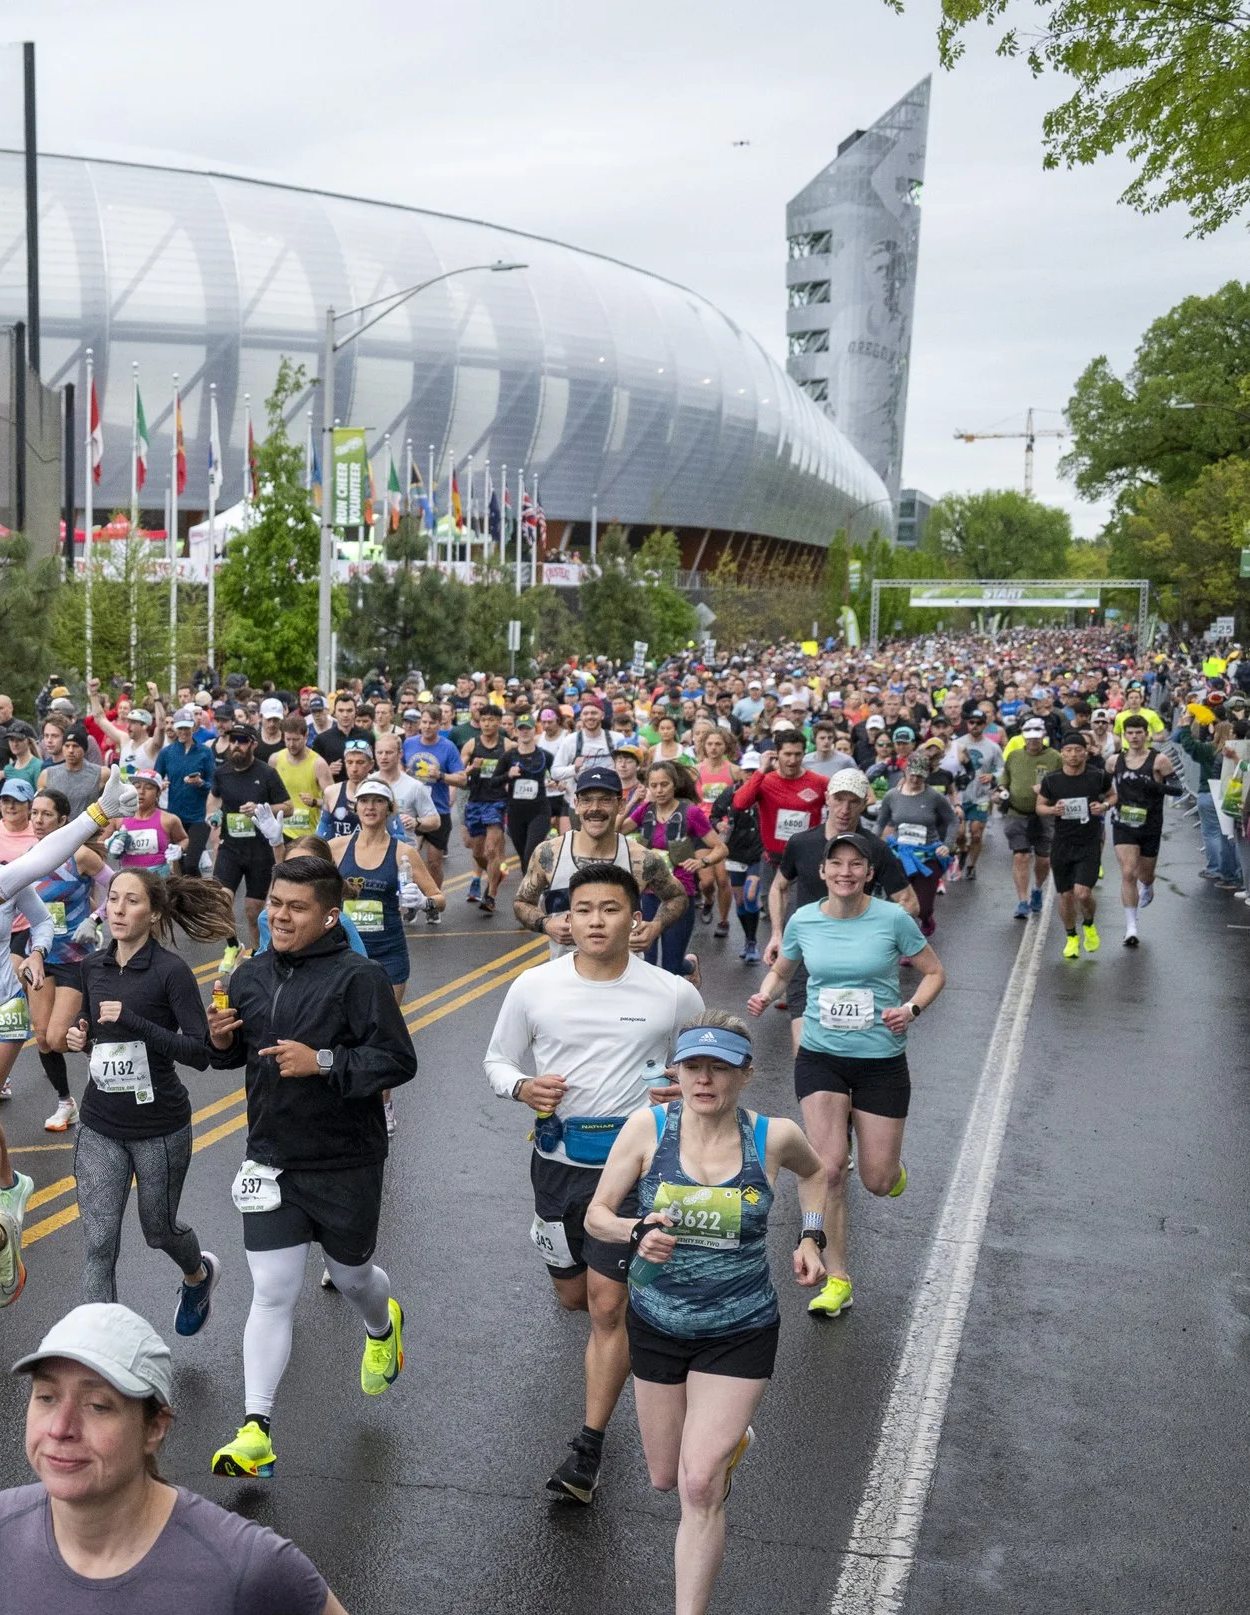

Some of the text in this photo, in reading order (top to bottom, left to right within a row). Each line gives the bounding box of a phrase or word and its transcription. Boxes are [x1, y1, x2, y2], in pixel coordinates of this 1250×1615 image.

[336, 462, 348, 524] RUN CHEER
[349, 462, 361, 524] VOLUNTEER
[982, 588, 1024, 600] START
[1217, 625, 1232, 635] 25
[333, 821, 363, 836] TEA
[783, 819, 803, 828] 6800
[351, 912, 375, 922] 3120
[830, 1003, 859, 1017] 6721
[102, 1060, 134, 1077] 7132
[241, 1178, 262, 1195] 537
